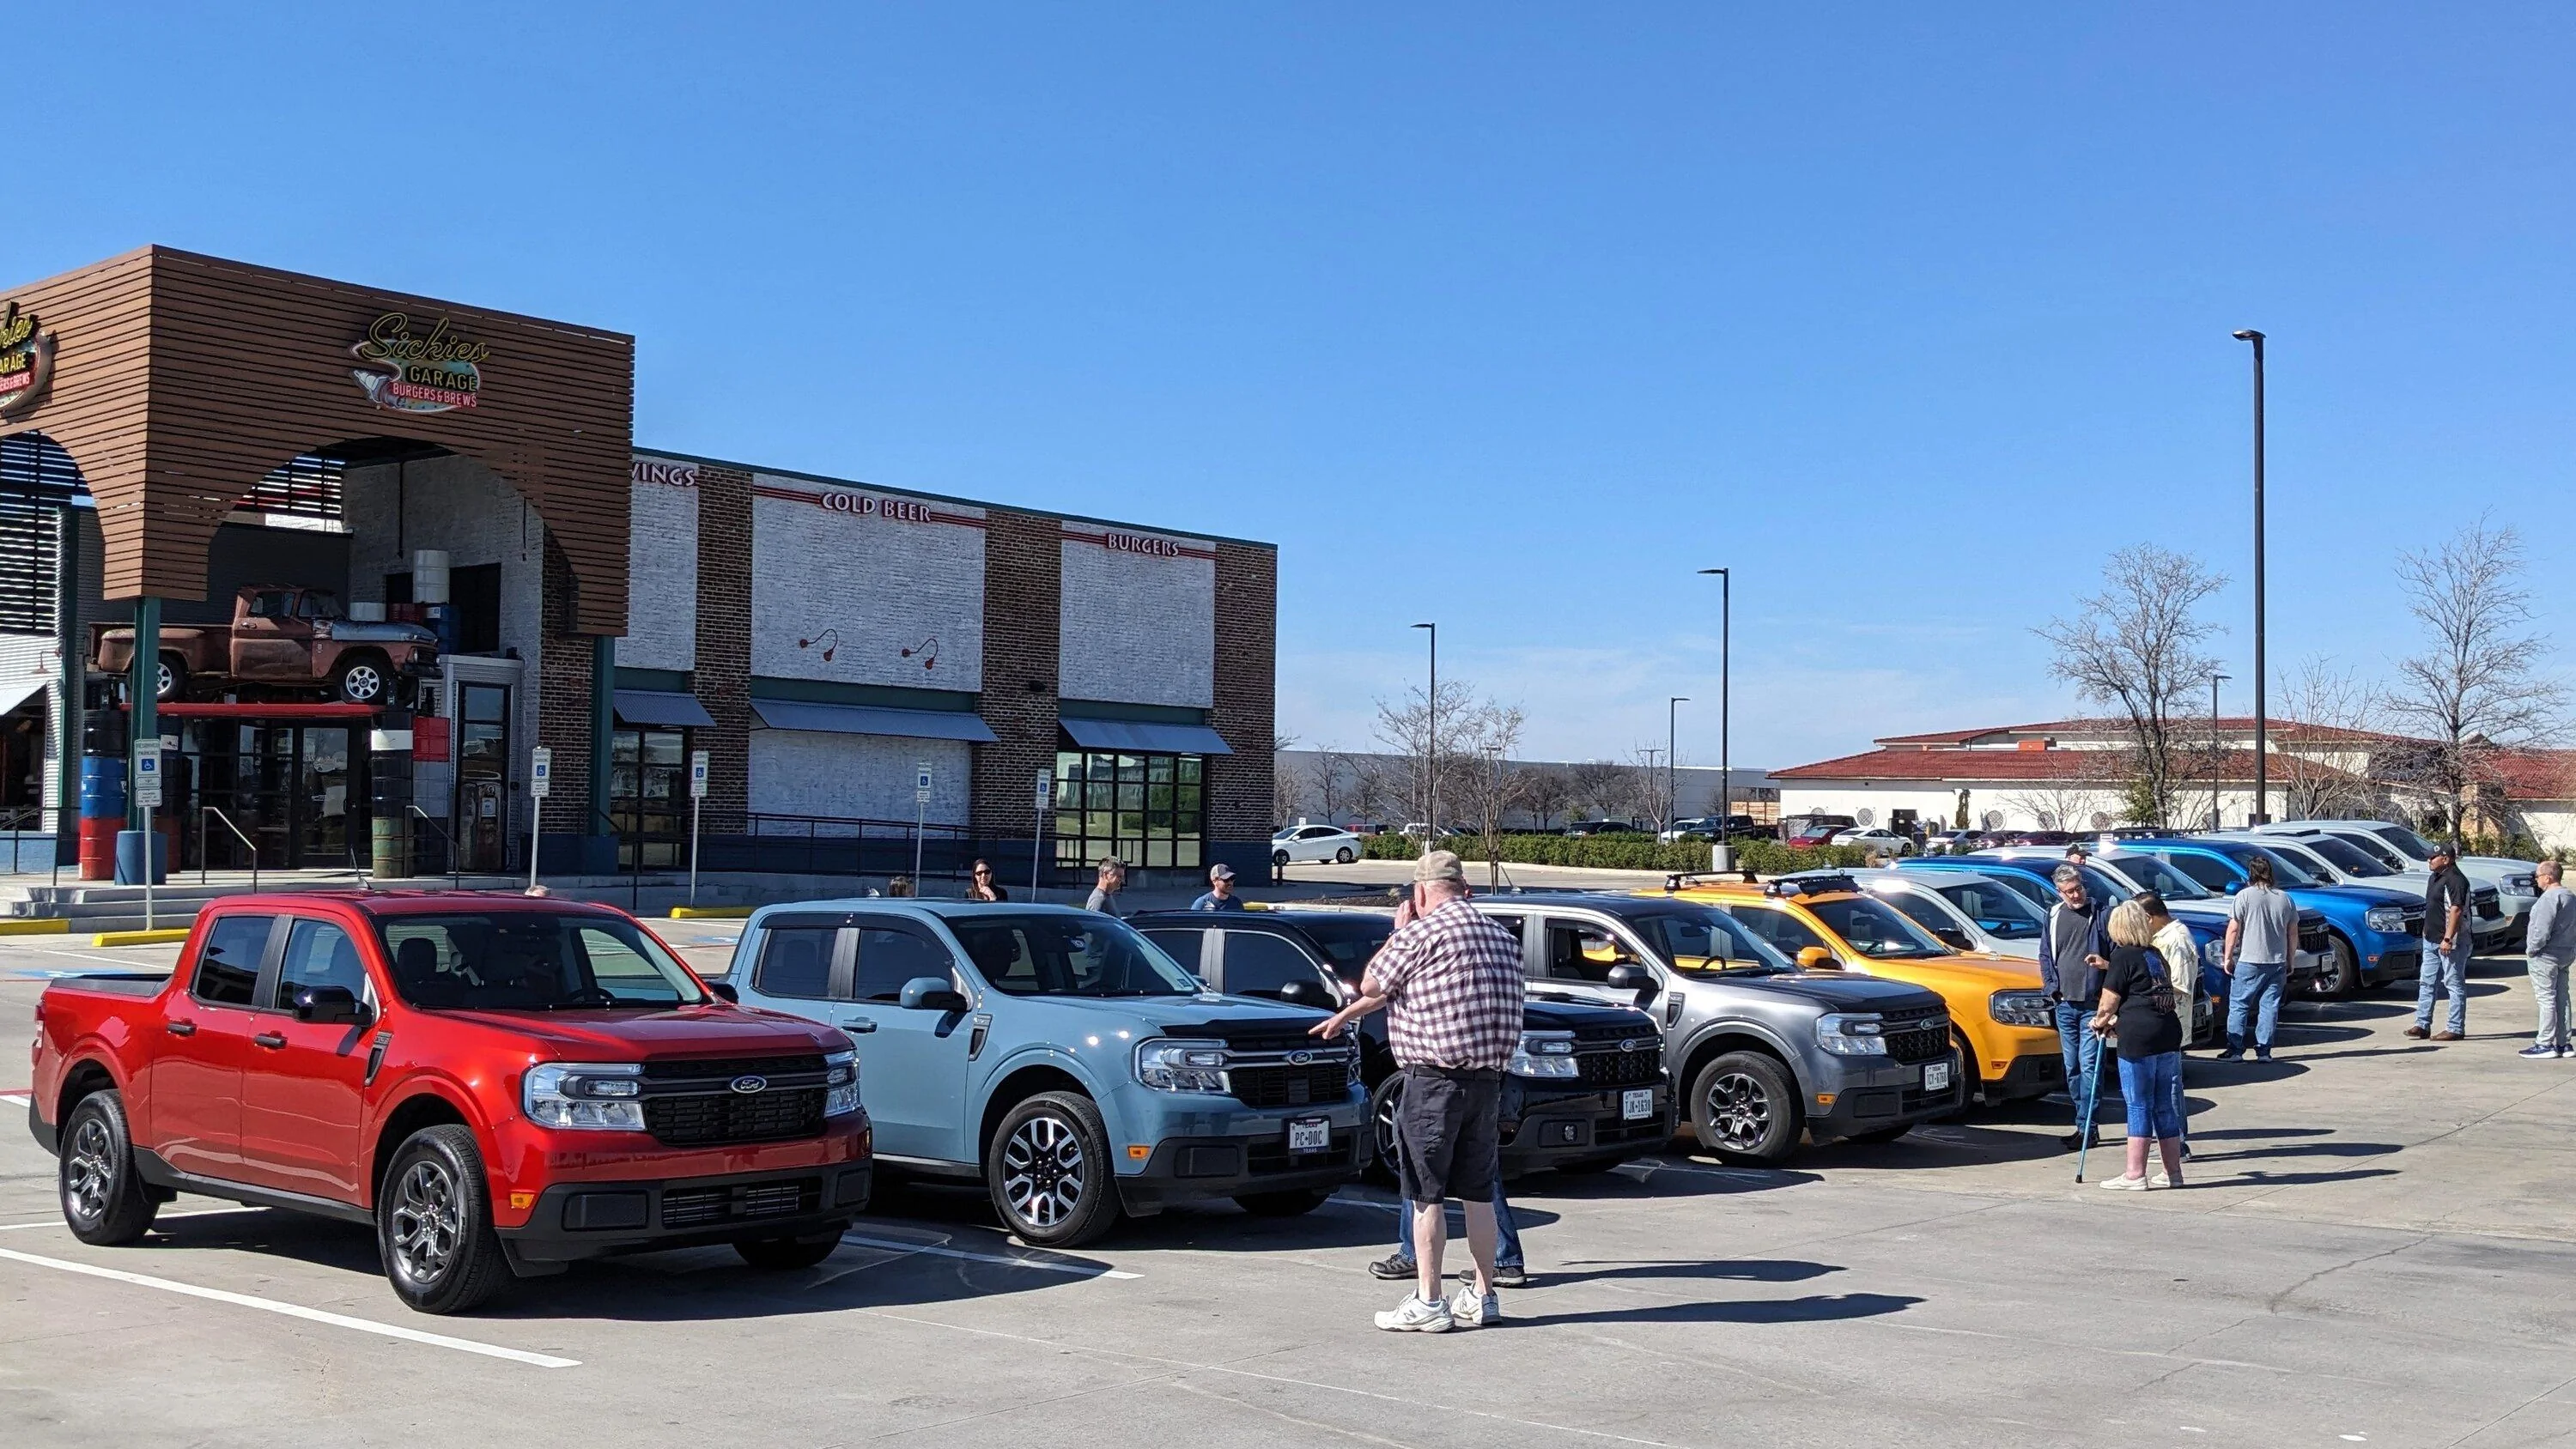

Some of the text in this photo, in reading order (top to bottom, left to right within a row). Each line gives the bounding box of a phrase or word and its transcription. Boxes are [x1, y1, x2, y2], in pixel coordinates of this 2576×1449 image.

[361, 312, 490, 363] Sickies
[410, 366, 477, 392] GARAGE
[822, 492, 931, 522] COLD BEER
[1108, 533, 1180, 556] BURGERS
